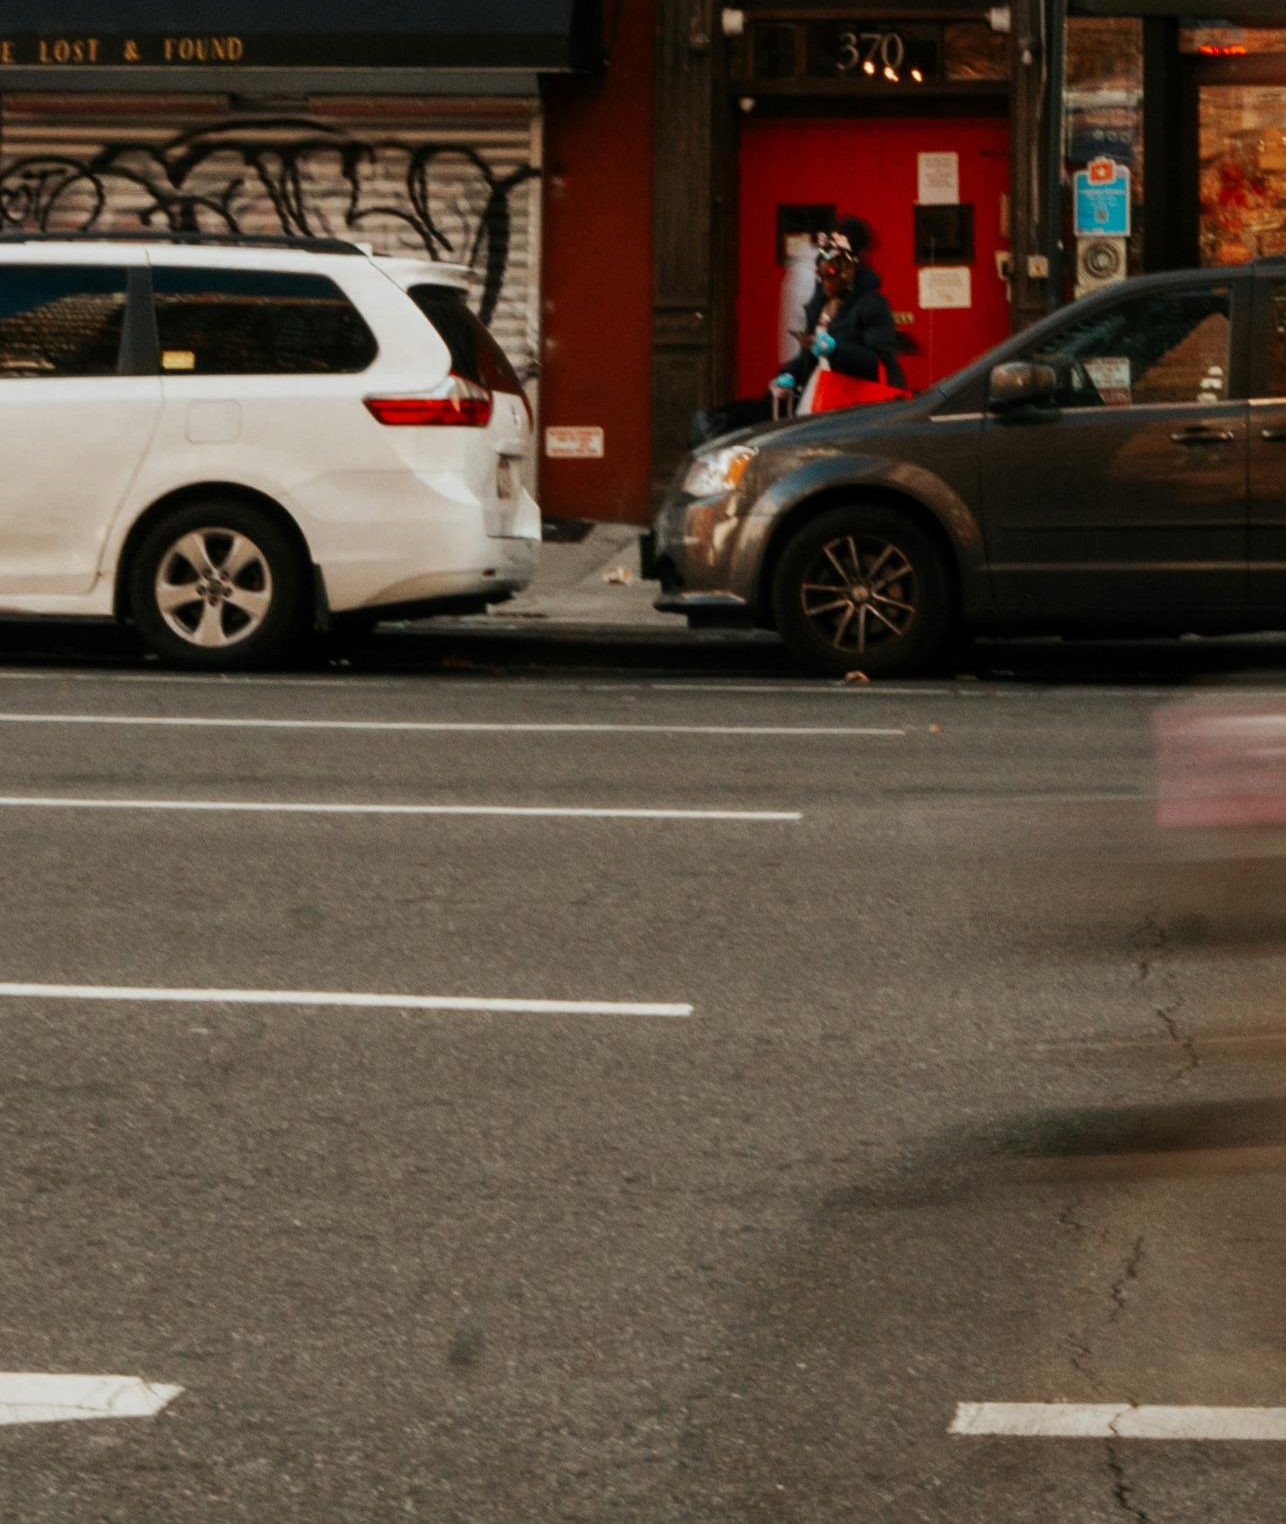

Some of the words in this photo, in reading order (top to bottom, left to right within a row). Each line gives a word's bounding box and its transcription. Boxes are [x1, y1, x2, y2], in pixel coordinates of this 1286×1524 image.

[39, 38, 99, 63] LOST
[123, 39, 142, 62] &
[163, 37, 244, 61] FOUND
[836, 32, 904, 72] 370
